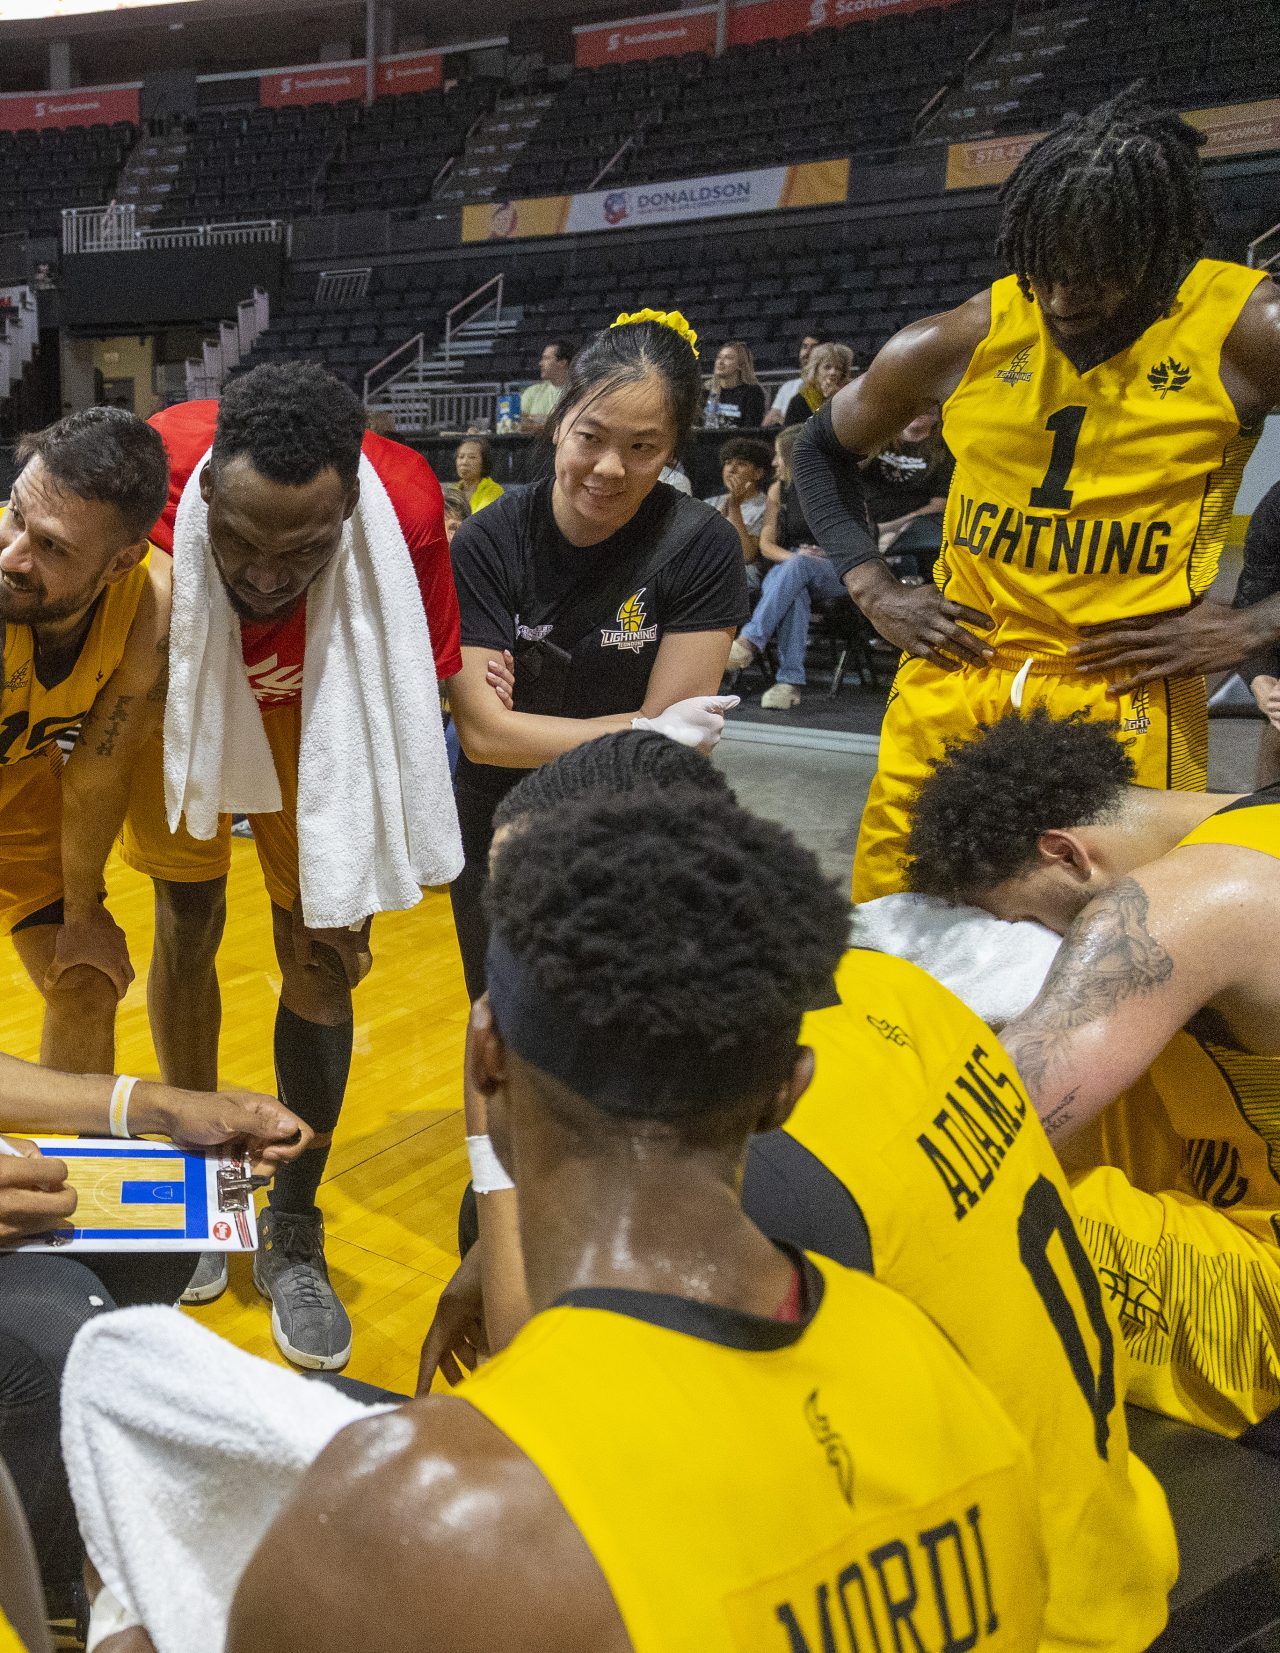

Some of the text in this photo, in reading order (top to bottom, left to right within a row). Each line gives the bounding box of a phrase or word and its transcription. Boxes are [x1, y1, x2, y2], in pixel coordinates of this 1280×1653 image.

[637, 182, 751, 208] DONALDSON
[1028, 405, 1088, 510] 1
[953, 494, 1171, 575] LIGHTNING
[604, 629, 655, 644] LIGHTNING
[916, 1044, 1027, 1222] ADAMS
[1017, 1172, 1116, 1462] 0
